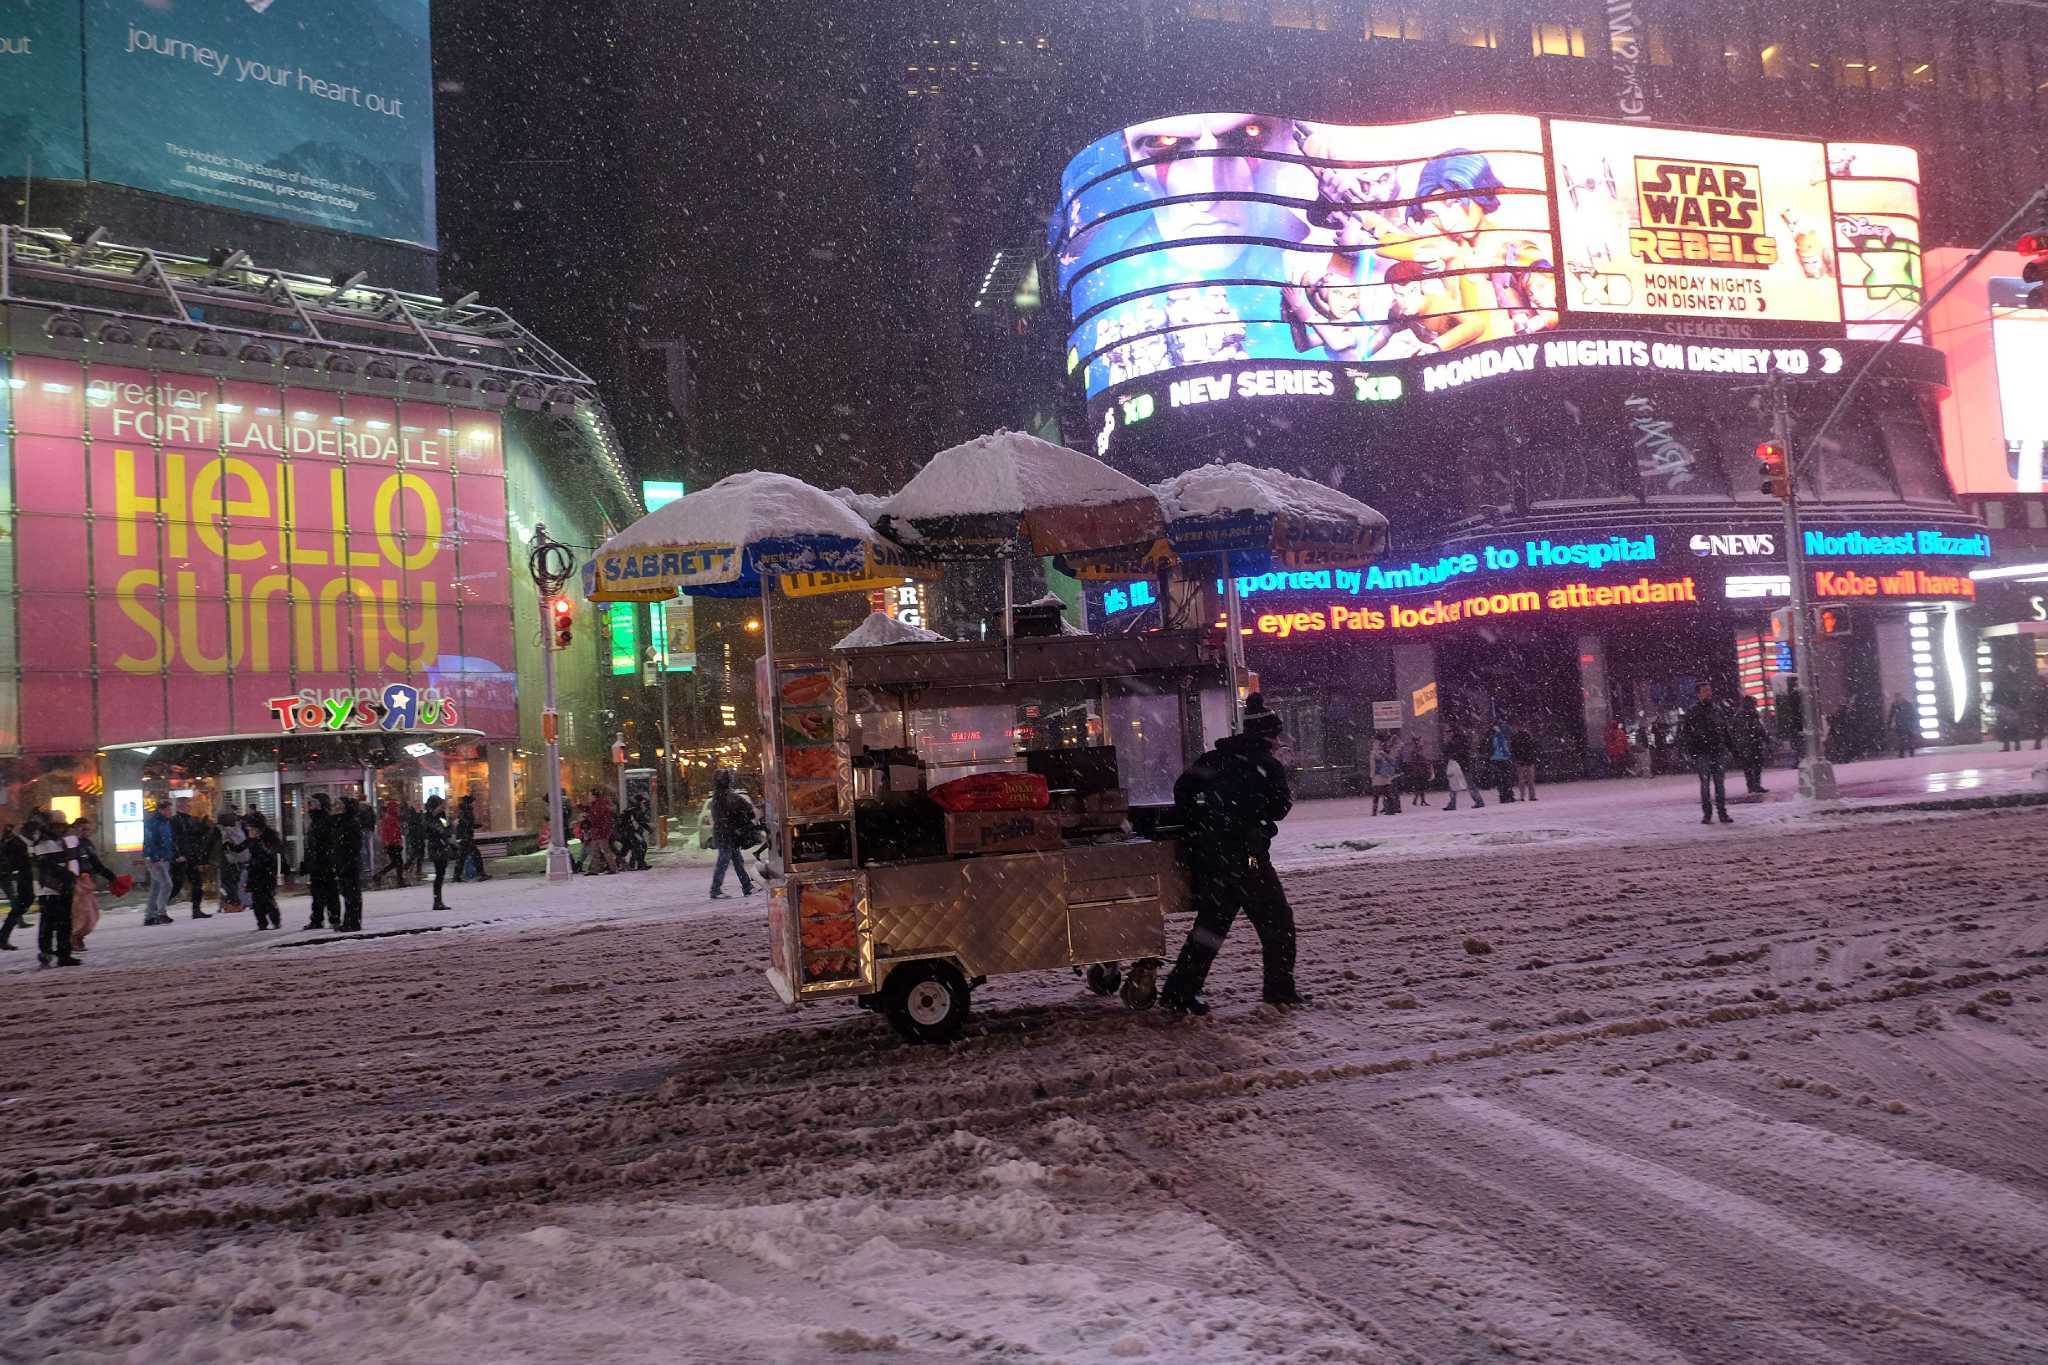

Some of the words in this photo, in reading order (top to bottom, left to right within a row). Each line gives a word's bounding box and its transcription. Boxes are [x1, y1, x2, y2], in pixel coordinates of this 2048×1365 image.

[126, 22, 229, 77] journey
[236, 57, 292, 83] your
[297, 68, 361, 108] heart
[365, 93, 405, 119] out
[1641, 165, 1757, 199] STAR
[1643, 194, 1759, 229] WARS
[1629, 227, 1778, 265] REBELS
[1644, 273, 1706, 289] MONDAY
[1711, 277, 1763, 293] NIGHTS
[1646, 293, 1668, 308] ON
[1673, 294, 1725, 310] DISNEY
[1728, 297, 1747, 311] XD
[1665, 321, 1752, 338] SIEMENS
[1423, 344, 1538, 392] MONDAY
[1544, 340, 1650, 368] NIGHTS
[1652, 343, 1685, 370] ON
[1687, 346, 1771, 374] DISNEY
[1773, 349, 1809, 374] XD
[89, 379, 208, 408] greater
[1170, 374, 1232, 408] NEW
[1237, 368, 1335, 397] SERIES
[113, 409, 212, 443] FORT
[223, 414, 439, 465] LAUDERDALE
[1708, 534, 1775, 556] NEWS
[1804, 530, 1916, 556] Northeast
[604, 547, 737, 581] SABRETT
[1335, 569, 1362, 595] by
[1484, 545, 1520, 570] to
[1526, 534, 1656, 568] Hospital
[1815, 570, 1878, 596] Kobe
[1880, 568, 1915, 596] will
[1916, 570, 1960, 595] have
[1257, 611, 1326, 638] eyes
[1331, 605, 1385, 631] Pats
[1464, 591, 1541, 618] room
[1547, 576, 1696, 609] attendant
[271, 696, 378, 730] TOYS
[420, 697, 458, 727] US
